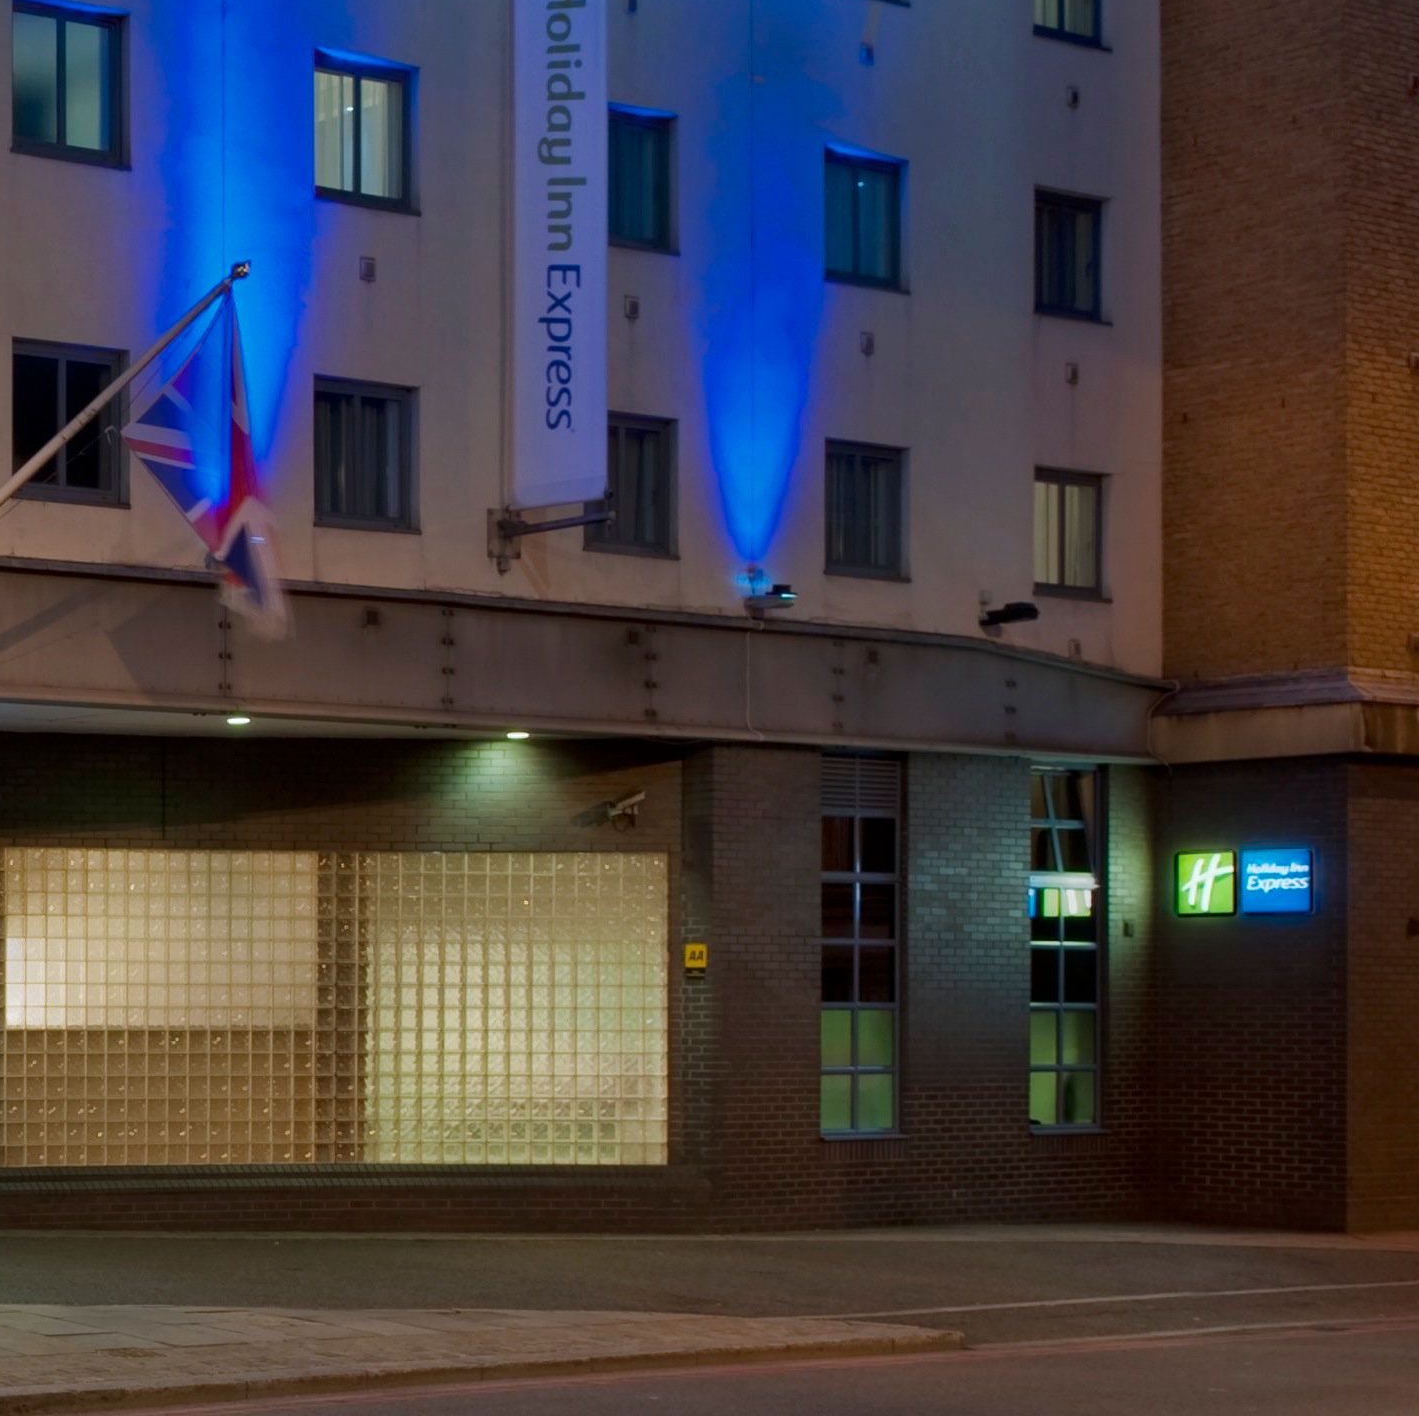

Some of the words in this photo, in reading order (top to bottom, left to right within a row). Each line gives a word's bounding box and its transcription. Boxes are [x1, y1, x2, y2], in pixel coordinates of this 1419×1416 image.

[546, 176, 588, 252] Inn
[537, 263, 581, 431] Express
[1246, 863, 1289, 875] Holiday
[1289, 862, 1309, 873] Inn
[1246, 875, 1309, 892] Express
[688, 950, 704, 961] AA
